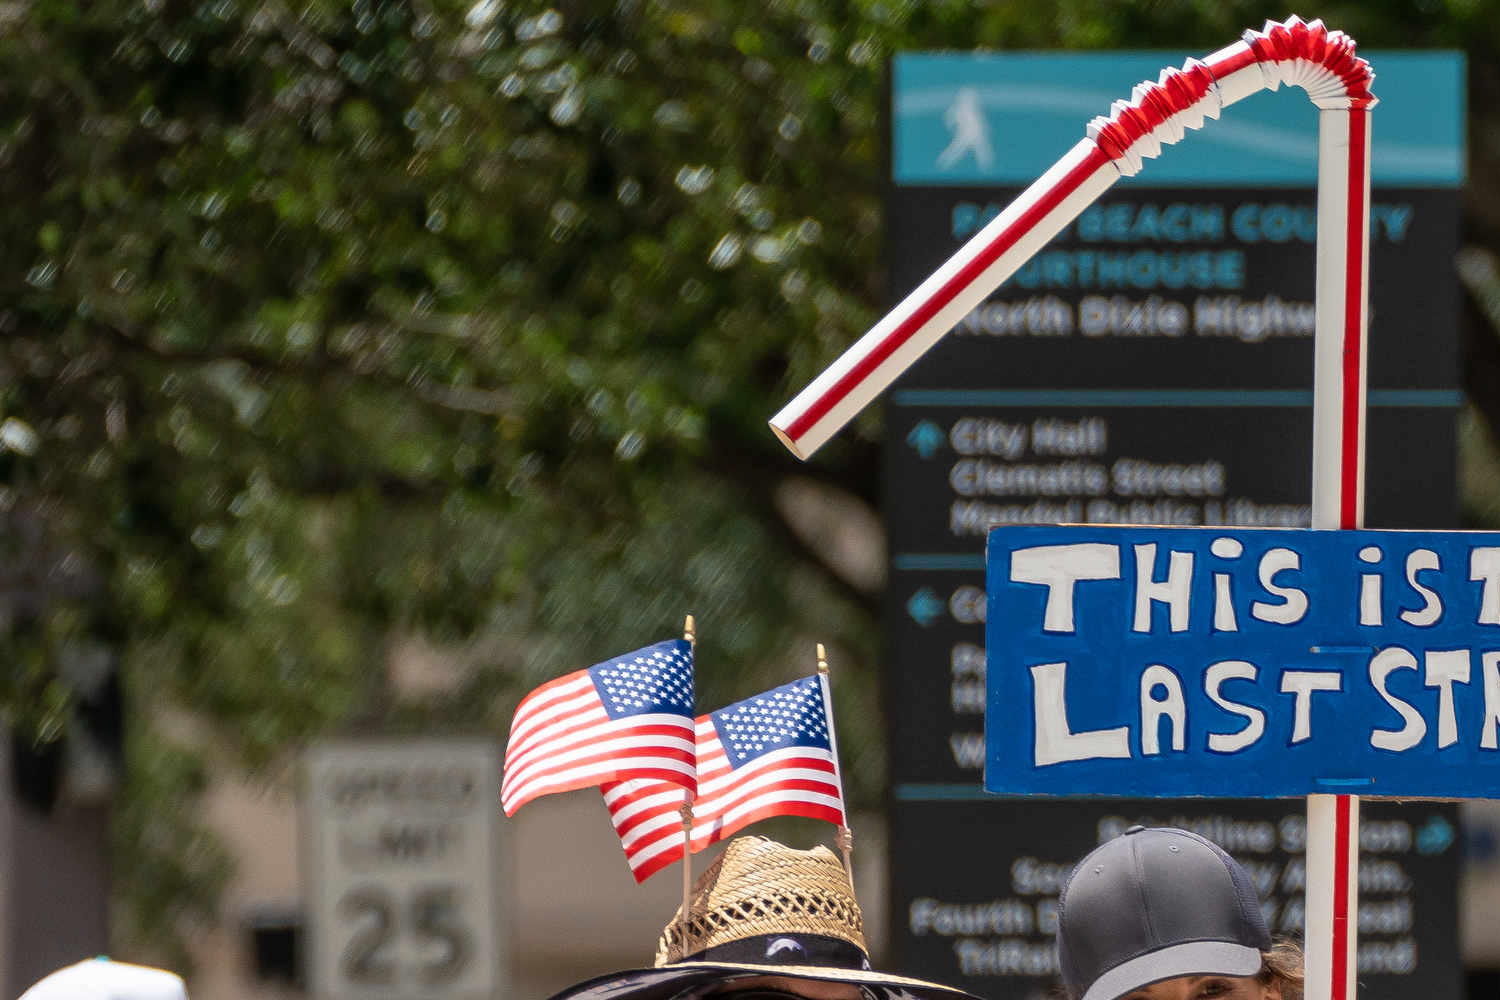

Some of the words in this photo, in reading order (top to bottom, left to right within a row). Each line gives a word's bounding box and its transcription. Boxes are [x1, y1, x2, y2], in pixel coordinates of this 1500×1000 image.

[1078, 204, 1223, 241] BEACH
[1232, 204, 1412, 242] COUTY
[1003, 251, 1245, 289] URTHOUSE
[1081, 296, 1187, 336] Dixie
[1195, 296, 1316, 341] Highw
[950, 418, 1024, 458] City
[1033, 418, 1106, 454] Hall
[950, 460, 1107, 495] Clematis
[1112, 460, 1224, 495] Street
[1030, 659, 1344, 768] LAST
[336, 882, 478, 986] 25
[909, 899, 1034, 936] Fourth
